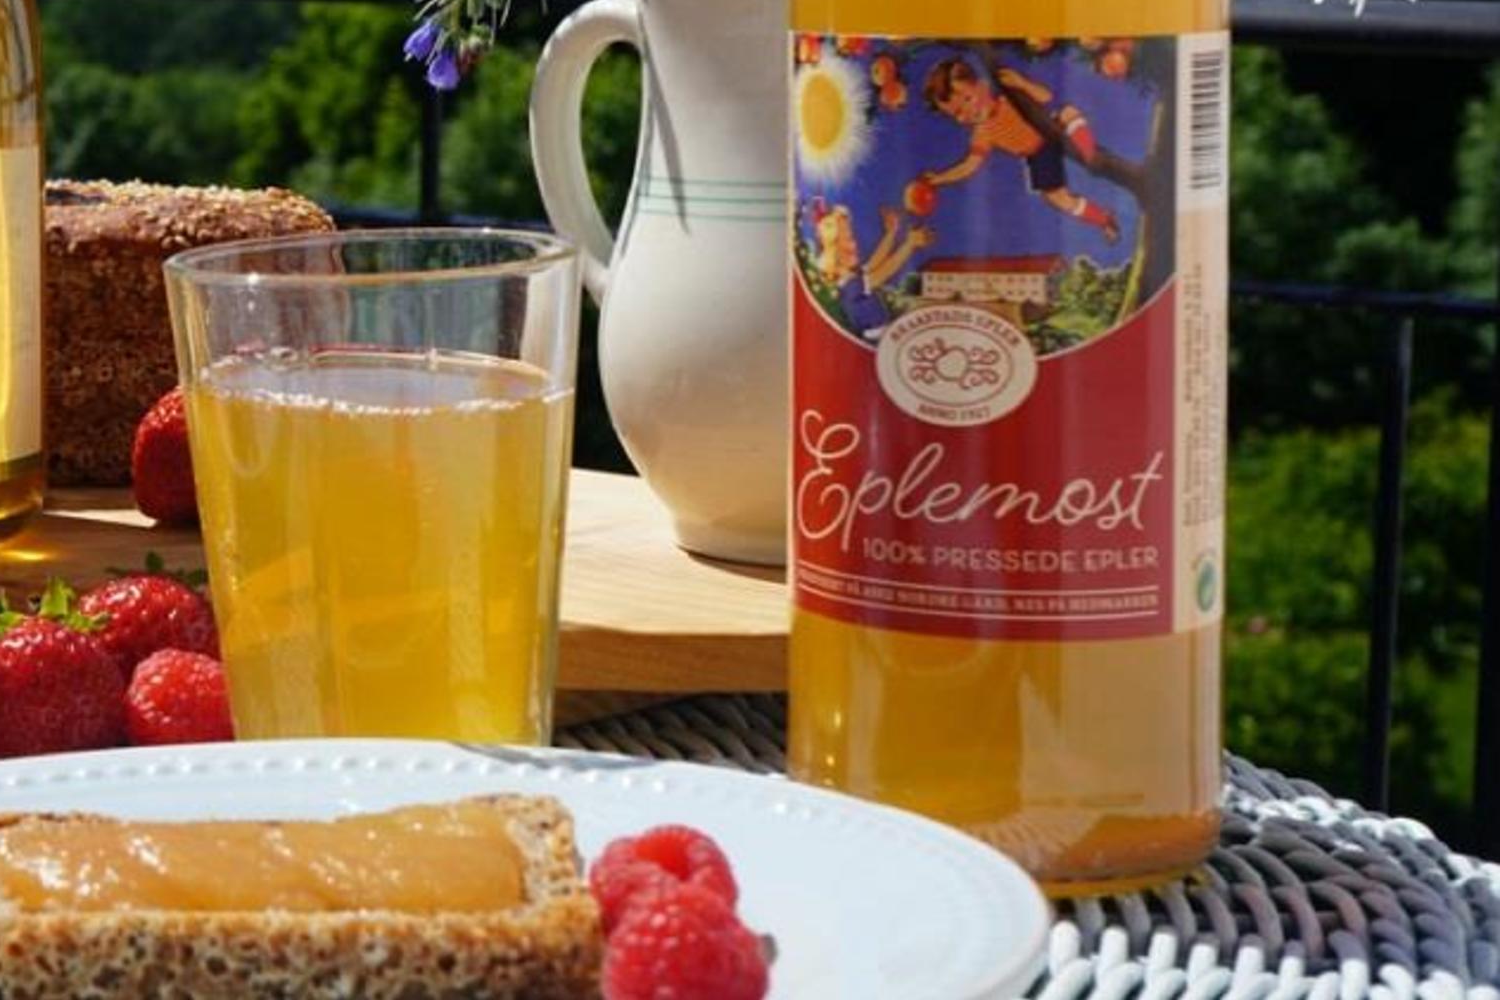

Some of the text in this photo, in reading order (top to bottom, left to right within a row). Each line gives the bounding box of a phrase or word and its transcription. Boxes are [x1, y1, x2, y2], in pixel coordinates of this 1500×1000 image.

[797, 410, 1164, 553] Eplemost
[862, 536, 1160, 574] 100% PRESSEDE EPLER
